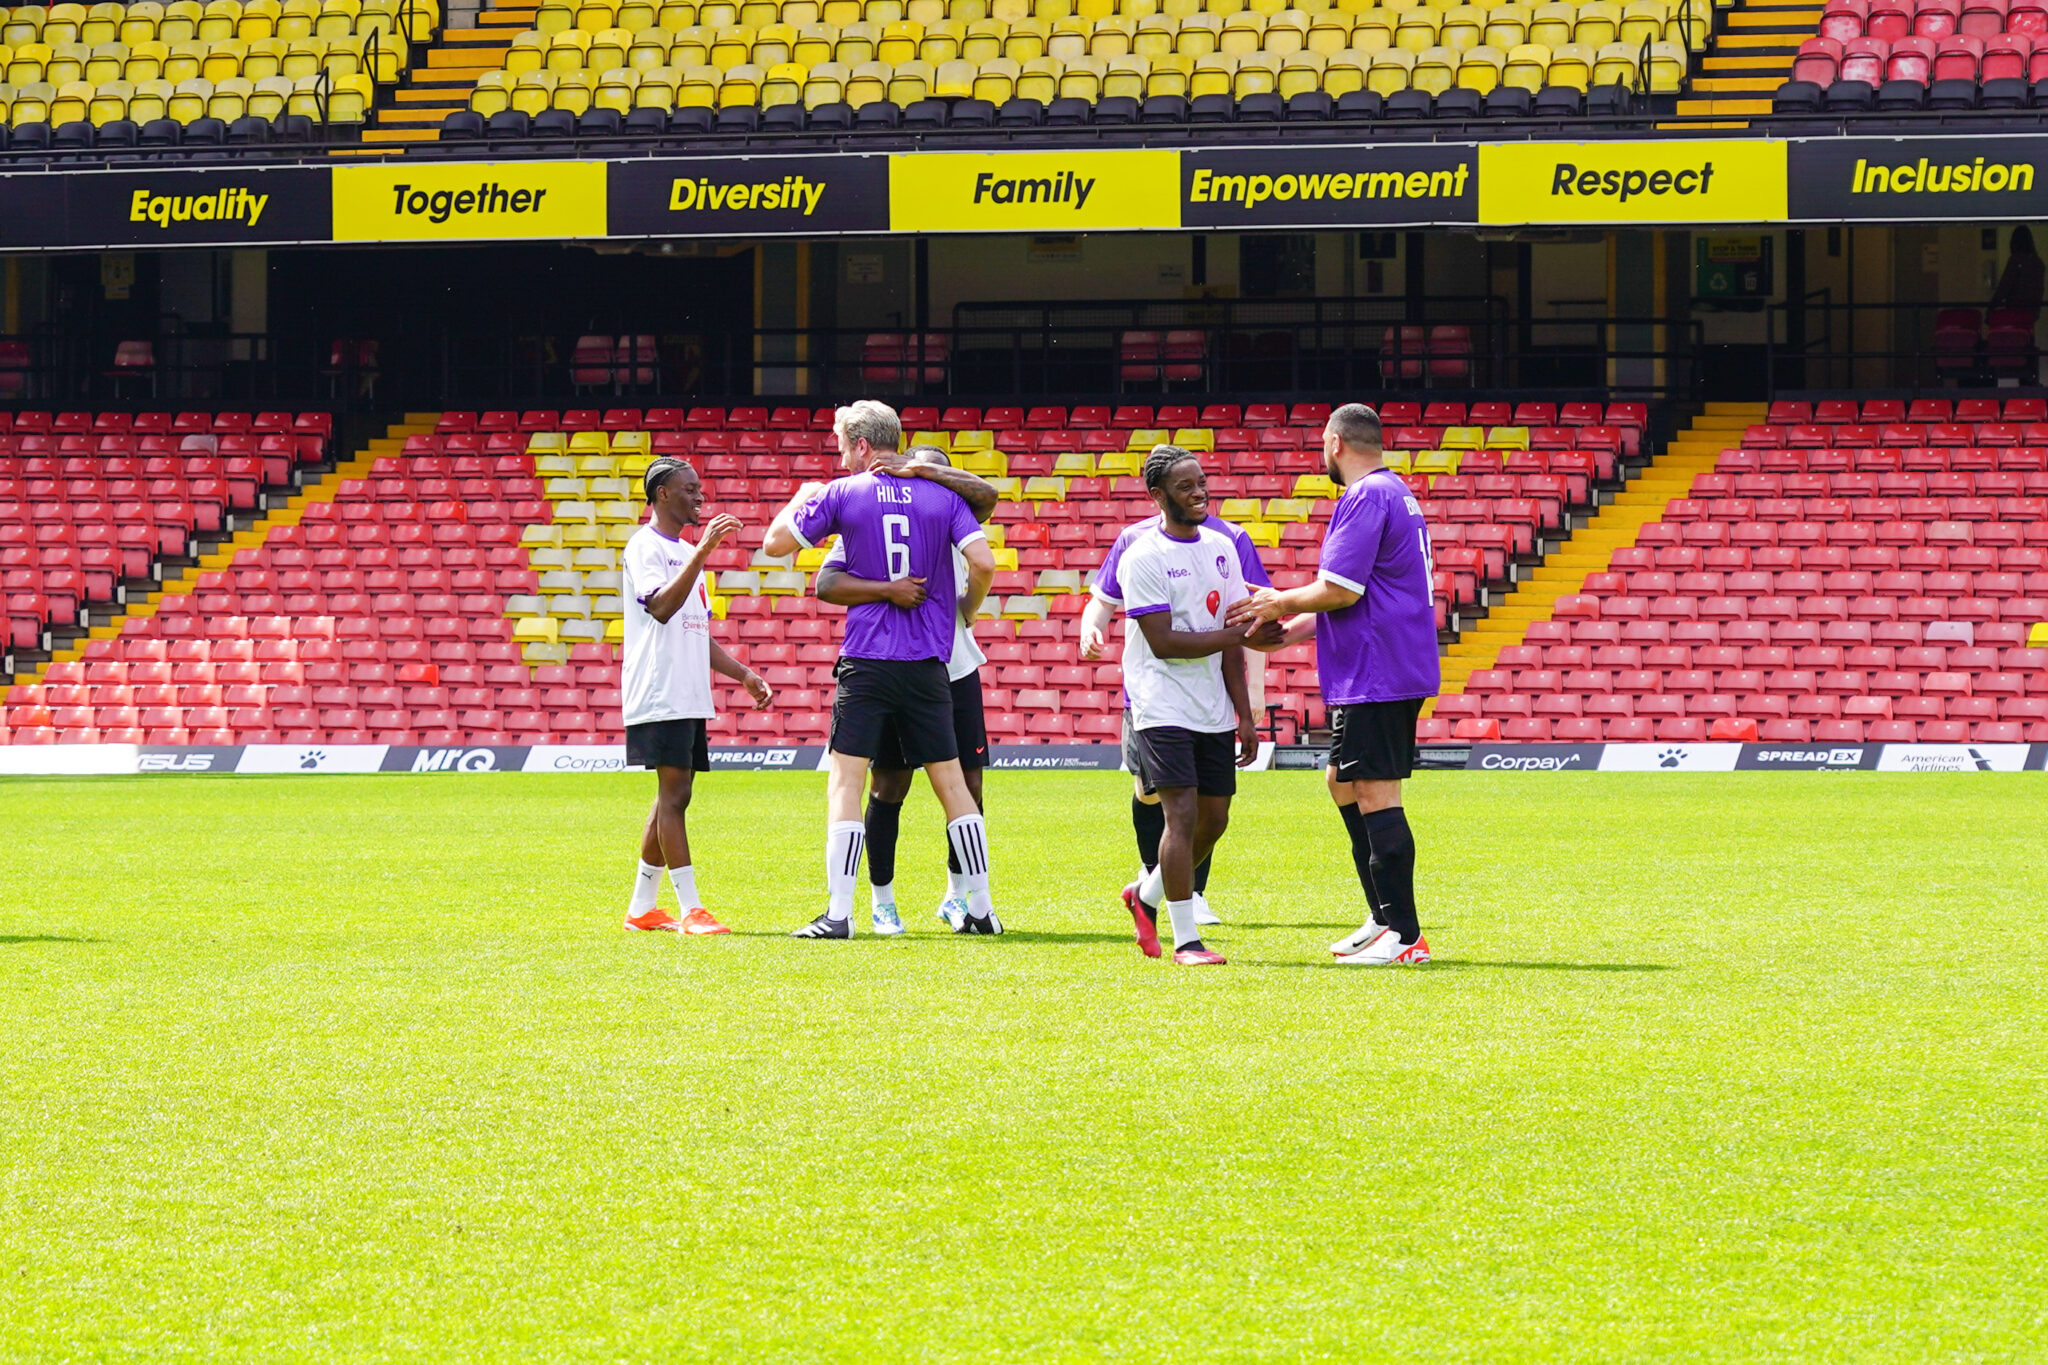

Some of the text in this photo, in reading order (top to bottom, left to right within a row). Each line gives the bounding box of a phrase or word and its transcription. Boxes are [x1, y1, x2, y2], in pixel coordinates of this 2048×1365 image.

[973, 171, 1096, 210] Family
[1190, 163, 1469, 209] Empowerment
[1551, 162, 1714, 202] Respect
[1852, 157, 2034, 193] Inclusion
[130, 187, 269, 228] Equality
[393, 183, 547, 224] Together
[669, 176, 826, 216] Diversity
[882, 513, 910, 582] 6
[992, 757, 1060, 767] ALAN DAY
[1481, 753, 1571, 772] Corpay
[1901, 754, 1965, 763] American
